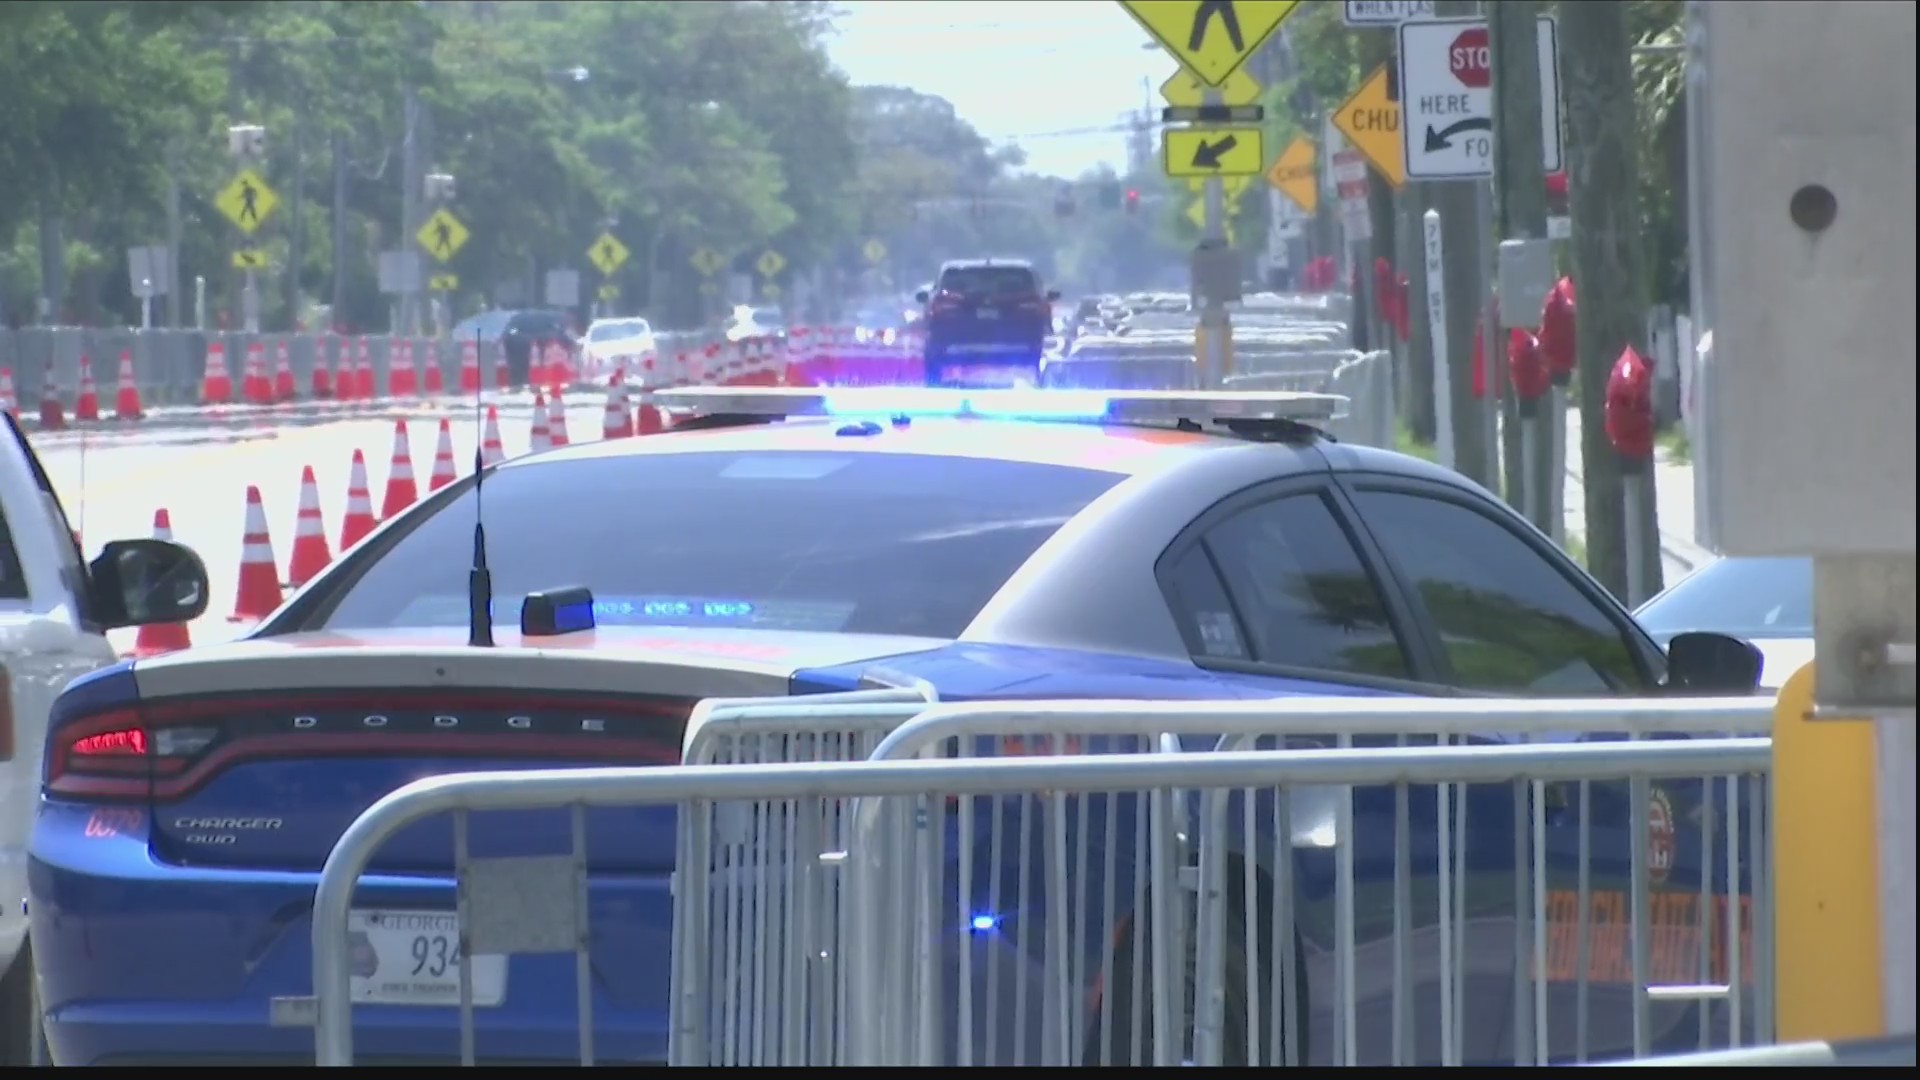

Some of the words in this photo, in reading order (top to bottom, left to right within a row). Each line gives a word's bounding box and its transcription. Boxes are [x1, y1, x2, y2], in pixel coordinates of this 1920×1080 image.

[1399, 1, 1434, 16] FLAS
[1452, 47, 1490, 70] STO
[1420, 94, 1472, 115] HERE
[1352, 108, 1399, 131] CHU
[1465, 138, 1490, 158] FO
[294, 715, 605, 731] DODGE
[174, 816, 283, 830] CHARGER
[383, 914, 458, 931] GEORGI
